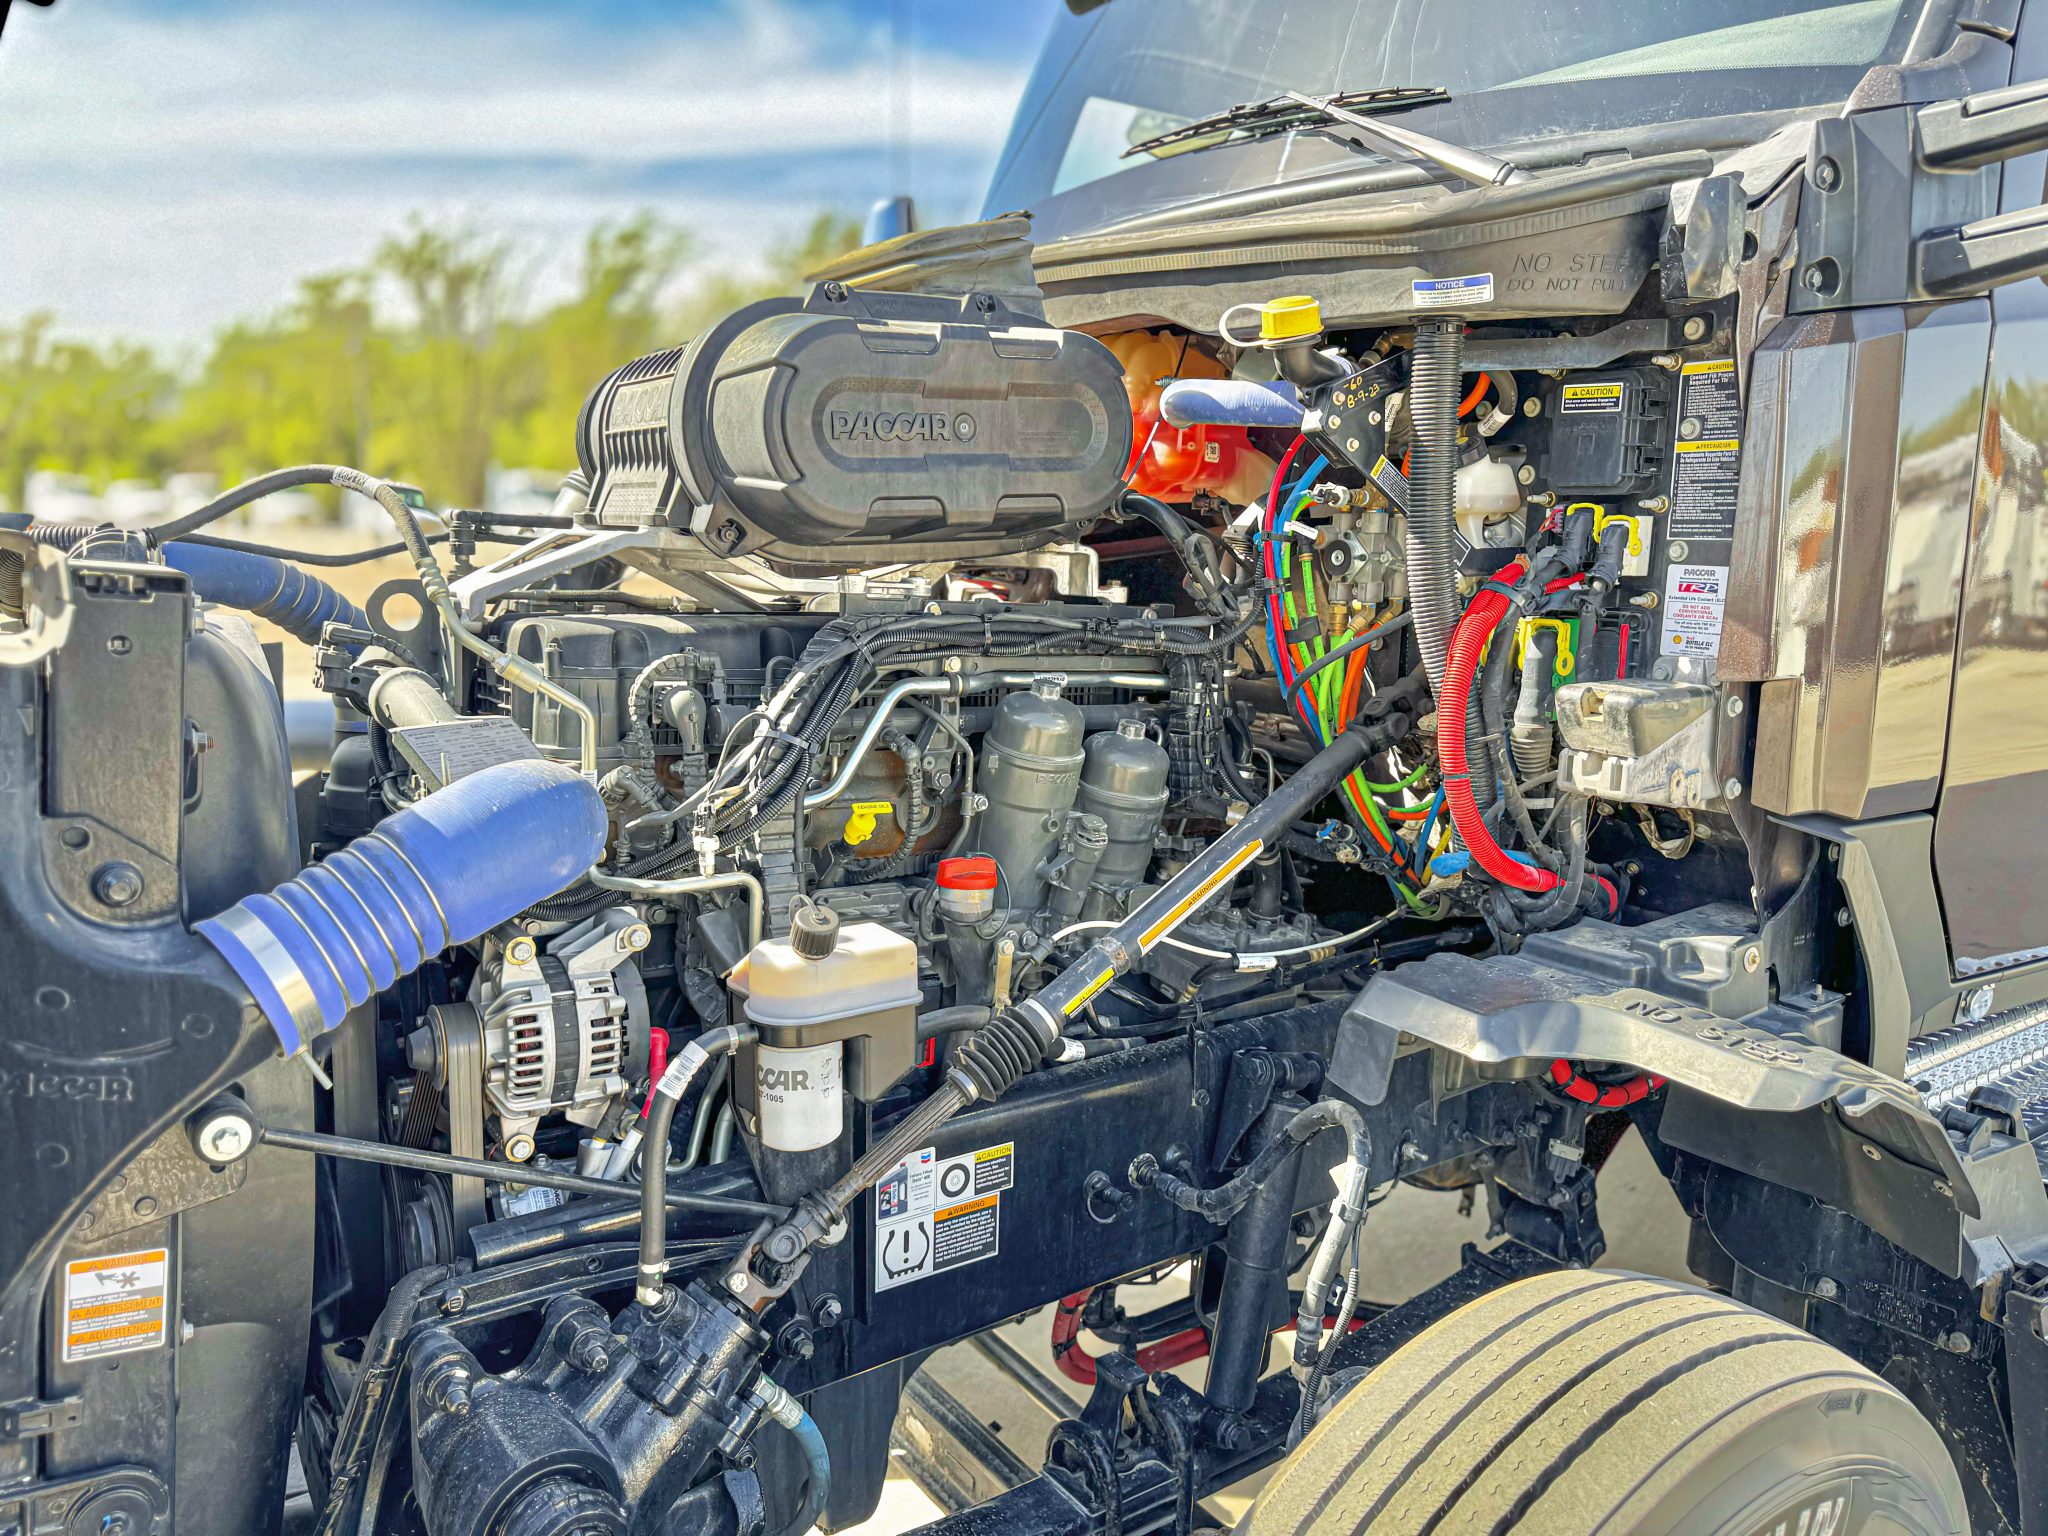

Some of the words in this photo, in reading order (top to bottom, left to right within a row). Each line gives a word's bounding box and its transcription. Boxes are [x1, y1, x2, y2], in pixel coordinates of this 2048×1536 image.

[1512, 252, 1551, 273] NO
[1435, 280, 1465, 290] NOTICE
[1507, 279, 1534, 292] DO
[1546, 279, 1579, 292] NOT
[1580, 388, 1613, 396] CAUTION
[831, 410, 951, 442] PACCAR
[1684, 568, 1716, 577] PACCAR
[1681, 582, 1719, 593] TRP
[1679, 607, 1713, 615] CONVENTIONAL
[1192, 878, 1218, 901] WARNING
[1624, 1000, 1682, 1024] NO
[1696, 1025, 1805, 1065] STEP
[982, 1147, 1010, 1159] CAUTION
[953, 1201, 984, 1214] WARNING
[102, 1255, 146, 1268] WARNING
[85, 1297, 160, 1316] AVERTISSEMENT
[89, 1322, 155, 1340] ADVERTENCIA
